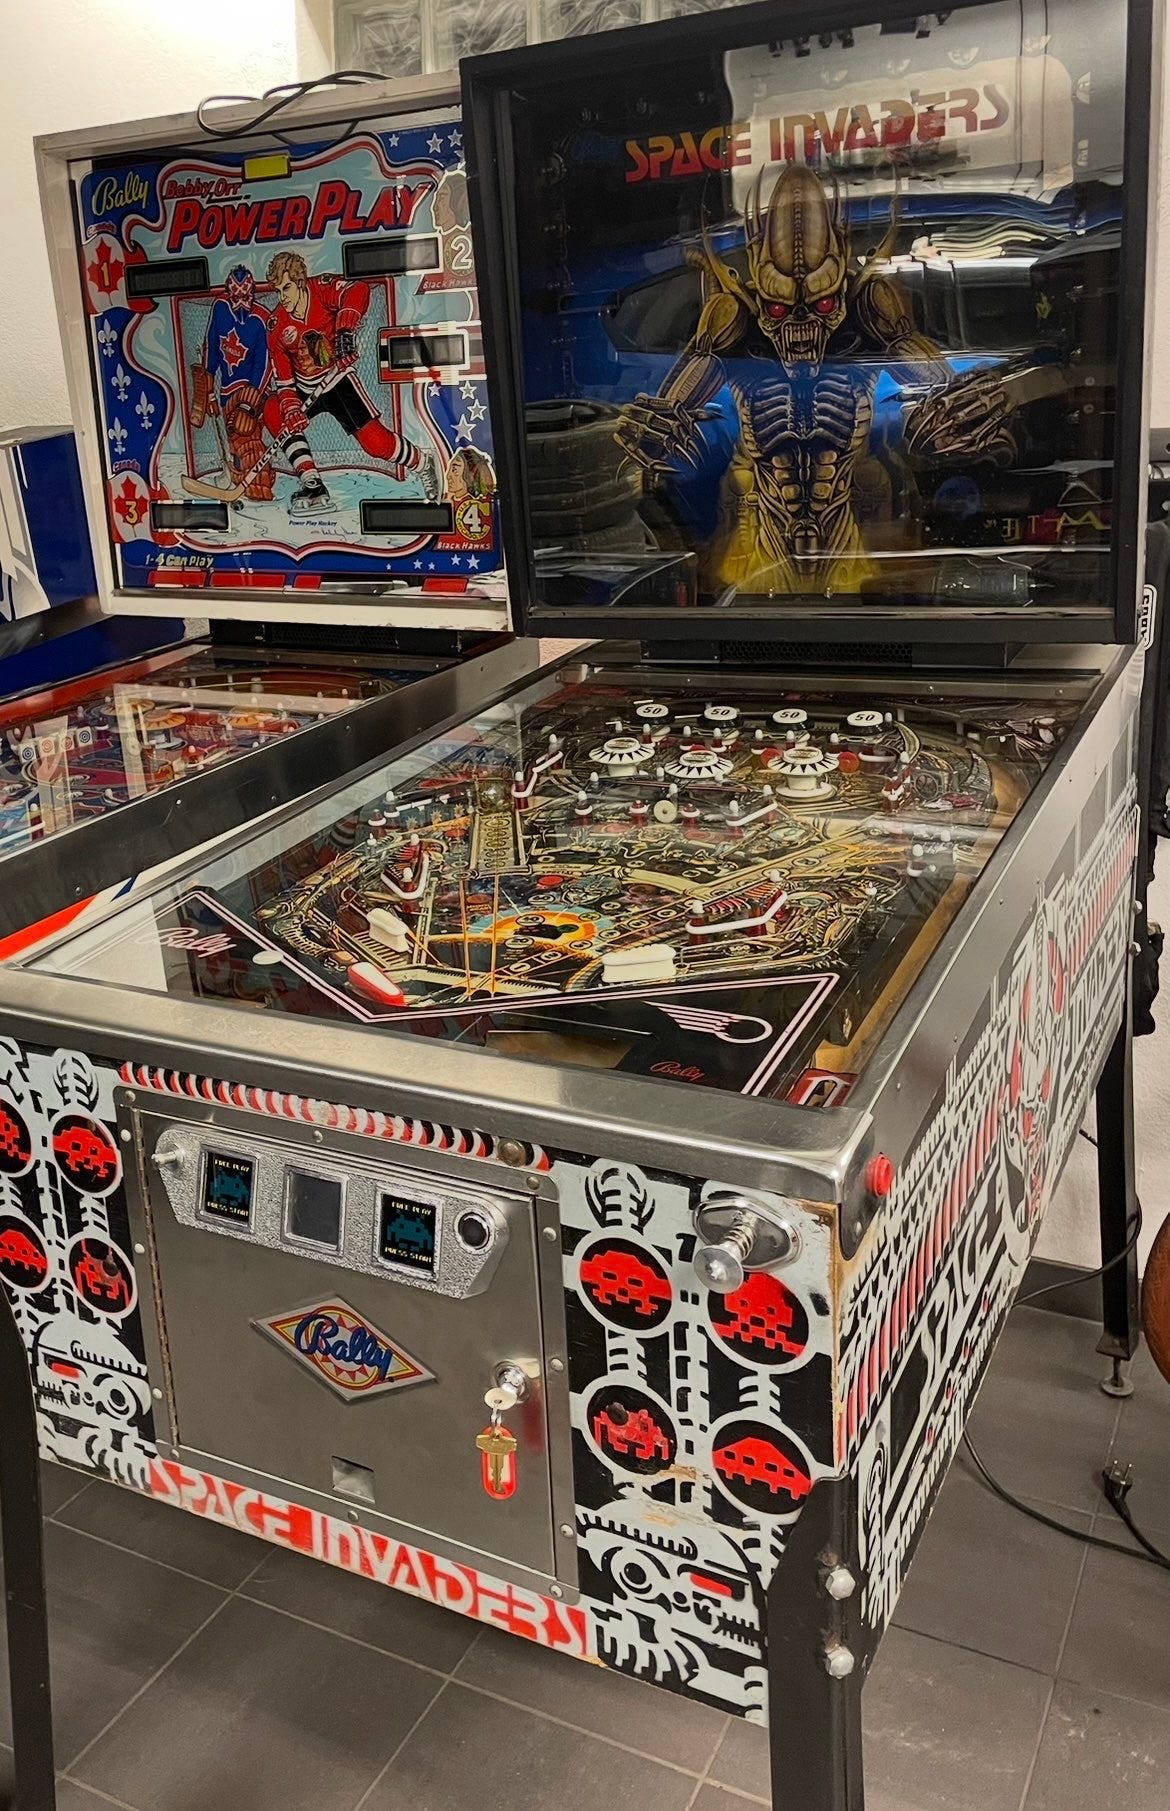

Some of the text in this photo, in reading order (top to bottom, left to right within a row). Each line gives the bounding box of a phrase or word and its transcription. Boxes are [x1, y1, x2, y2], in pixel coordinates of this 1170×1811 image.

[626, 83, 1010, 183] SPACE INVADERS
[91, 171, 149, 216] Bally
[165, 177, 243, 200] Bobby Orr
[166, 180, 435, 253] POWER PLAY
[451, 234, 474, 271] 2
[101, 262, 111, 288] 1
[125, 501, 139, 524] 3
[462, 502, 481, 533] 4
[145, 553, 214, 569] 1-4 Can Play
[642, 706, 662, 715] 50
[711, 708, 731, 717] 50
[779, 710, 800, 720] 50
[854, 713, 876, 723] 50
[135, 927, 237, 958] Bally
[650, 1060, 706, 1082] Bally
[293, 1312, 394, 1381] Bally
[150, 1457, 585, 1654] SPACE INVADERS
